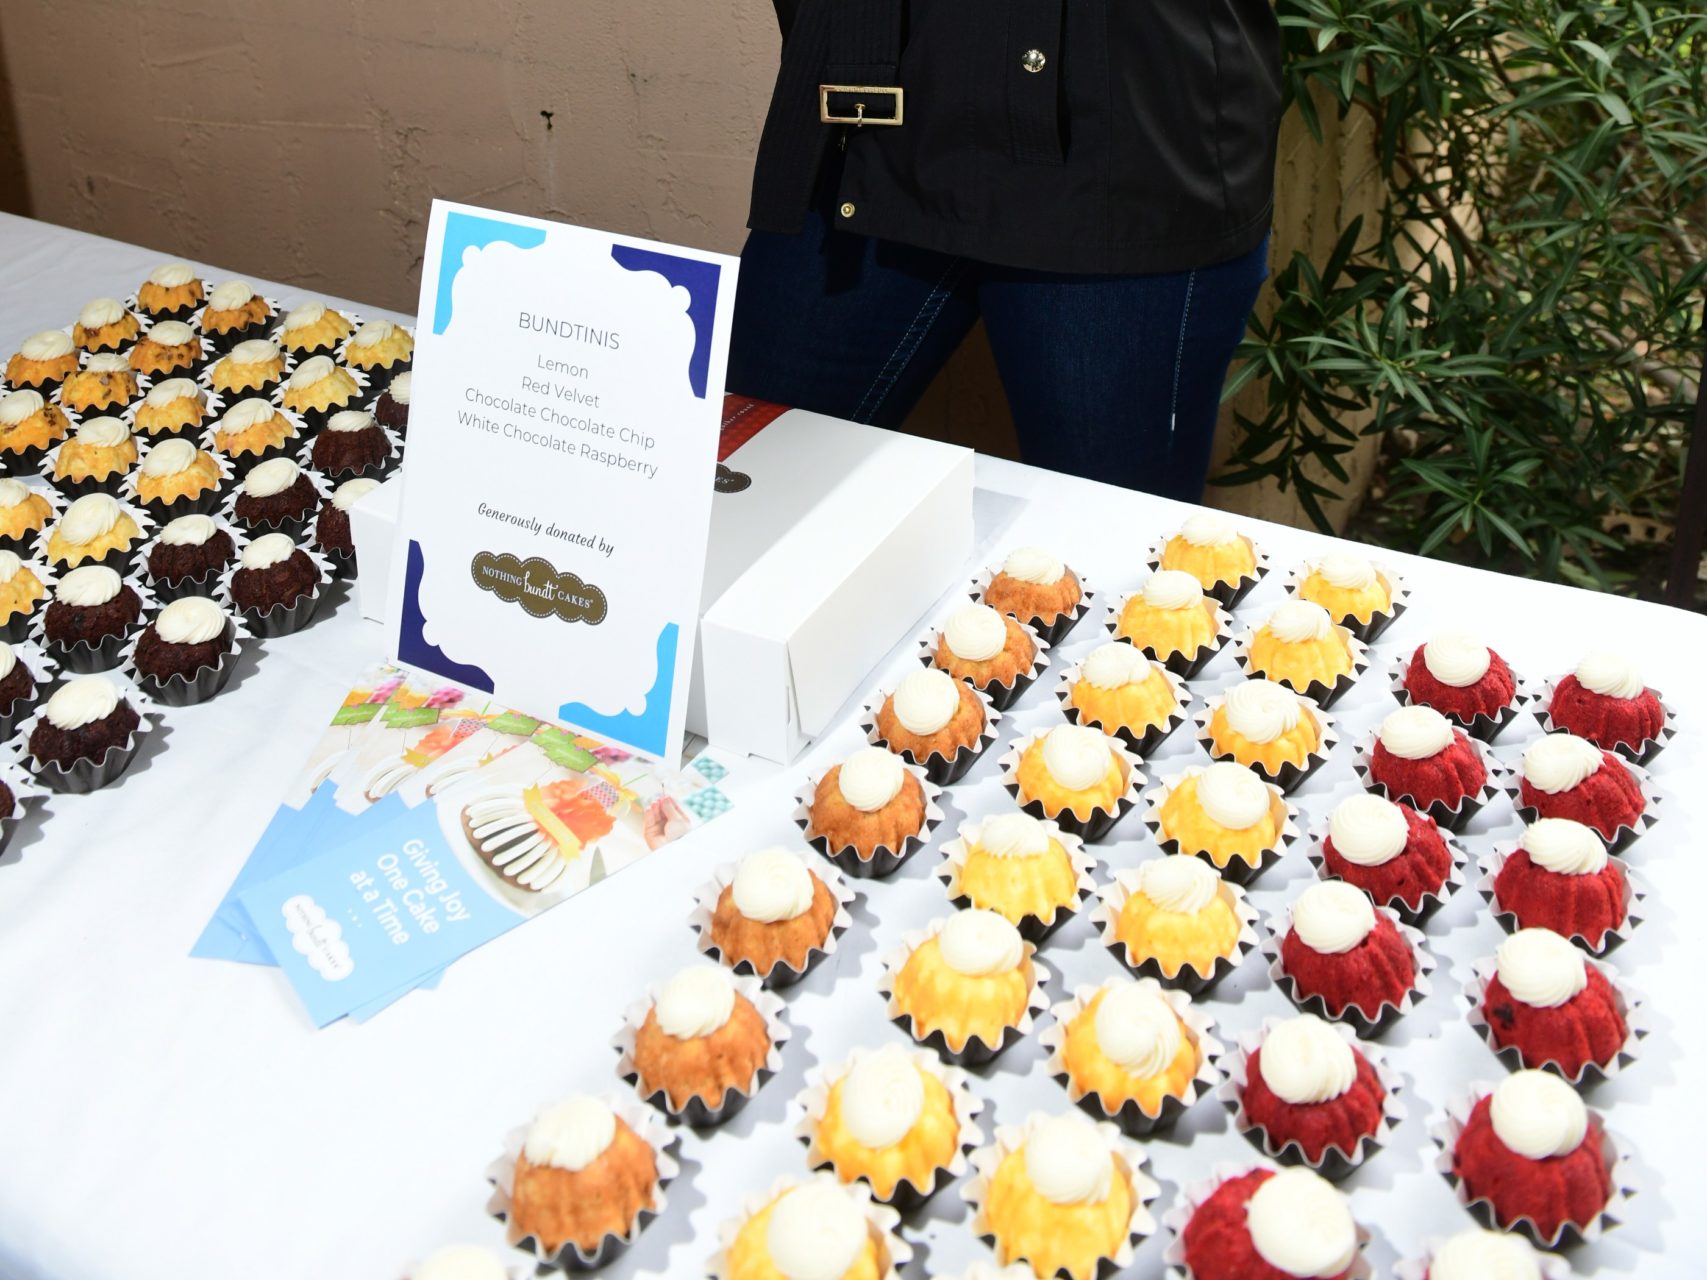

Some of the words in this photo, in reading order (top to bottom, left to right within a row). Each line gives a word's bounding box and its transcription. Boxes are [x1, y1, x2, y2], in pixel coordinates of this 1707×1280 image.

[519, 311, 620, 350] BUNDTINIS
[537, 354, 589, 379] Lemon
[522, 375, 550, 395] Red
[554, 383, 600, 408] Velvet
[465, 387, 537, 418] Chocolate
[540, 407, 615, 439] Chocolate
[619, 427, 655, 451] Chip
[458, 410, 500, 434] White
[503, 423, 576, 455] Chocolate
[580, 443, 658, 480] Raspberry
[478, 502, 542, 536] Generously
[545, 522, 597, 549] donated
[598, 537, 615, 558] by
[482, 565, 523, 586] NOTHING
[523, 570, 559, 601] bundt
[350, 870, 375, 891] at
[362, 889, 380, 903] a
[377, 853, 408, 891] One
[402, 889, 440, 934] Cake
[402, 839, 448, 895] Giving
[438, 891, 471, 922] Joy
[372, 897, 410, 945] Time
